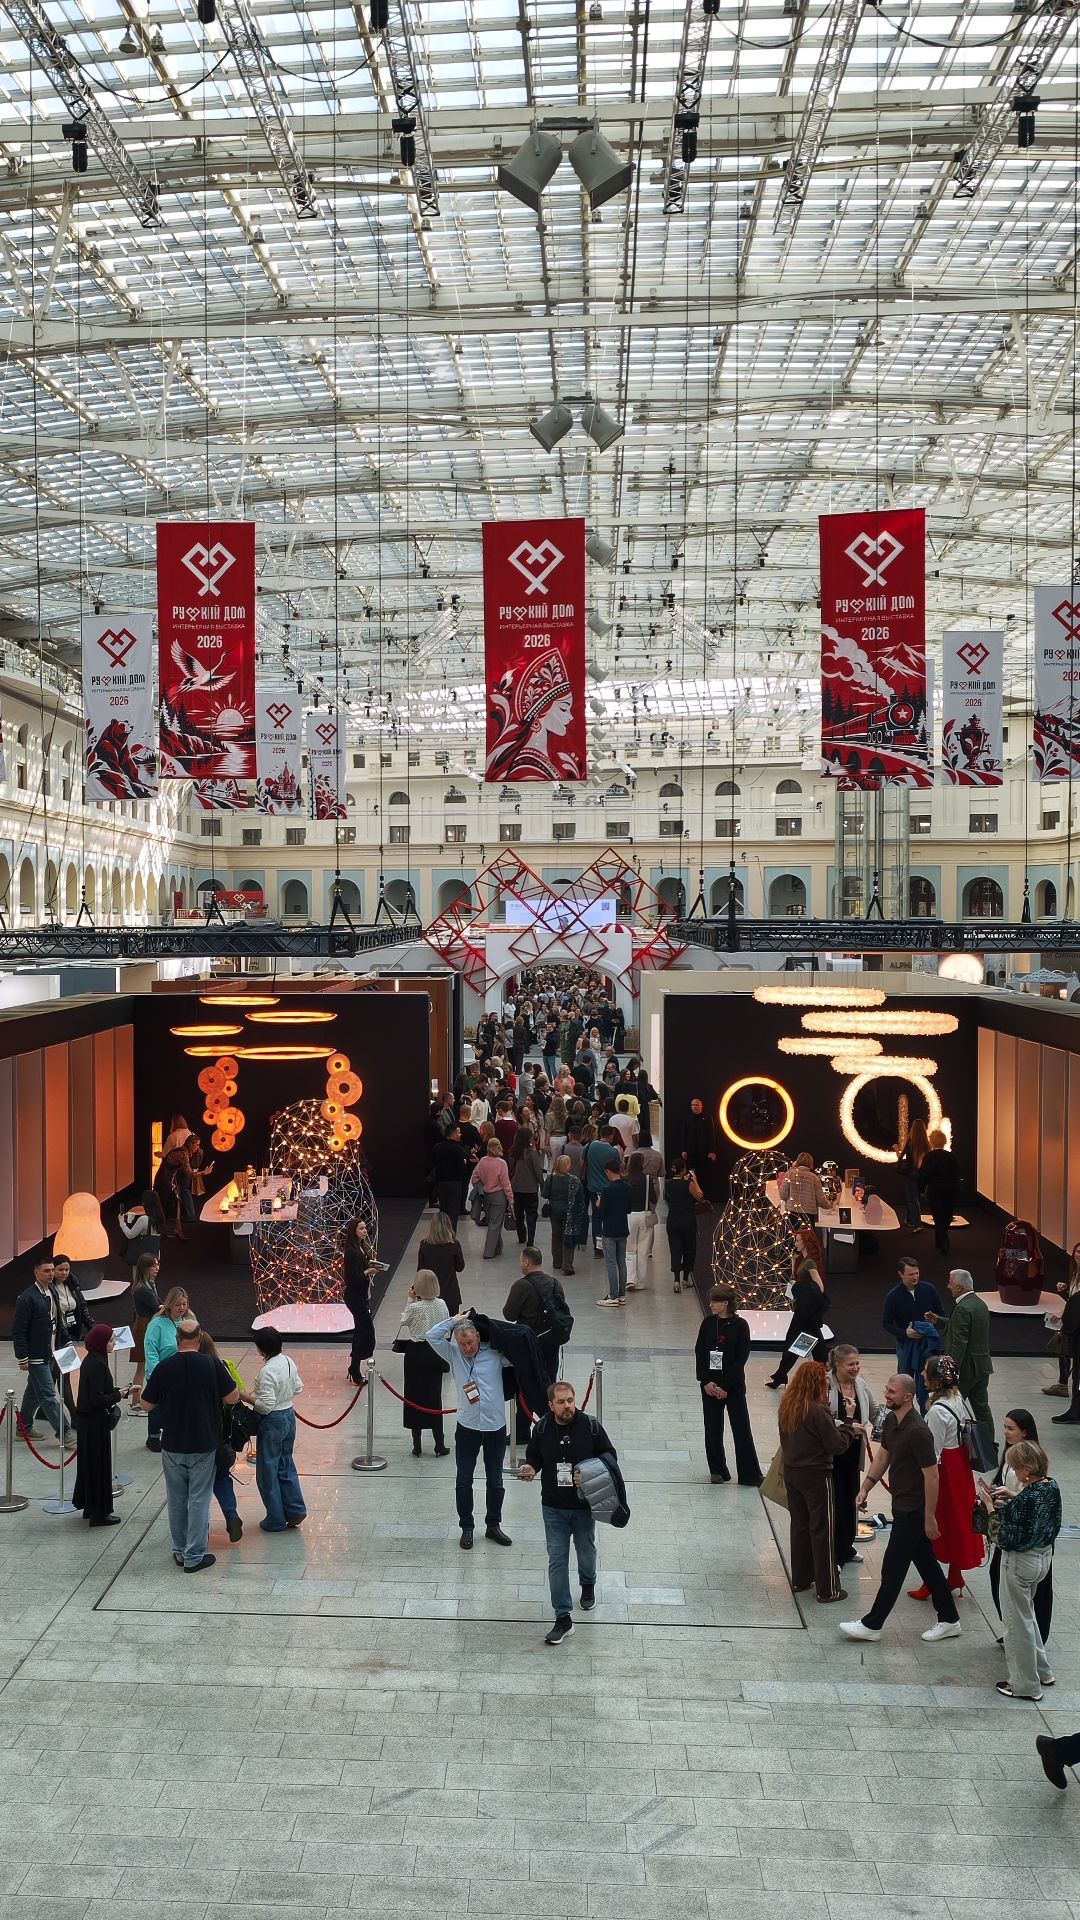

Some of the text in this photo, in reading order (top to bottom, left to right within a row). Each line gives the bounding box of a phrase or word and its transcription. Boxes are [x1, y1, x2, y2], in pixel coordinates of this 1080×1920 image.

[890, 595, 915, 612] ДОМ
[223, 606, 246, 622] ДОМ
[552, 603, 575, 620] ДОМ
[861, 626, 890, 641] 2026
[197, 635, 223, 648] 2026
[524, 634, 551, 648] 2026
[129, 673, 146, 686] ДОМ
[982, 681, 996, 691] ДОМ
[109, 695, 129, 706] 2026
[965, 698, 982, 707] 2026
